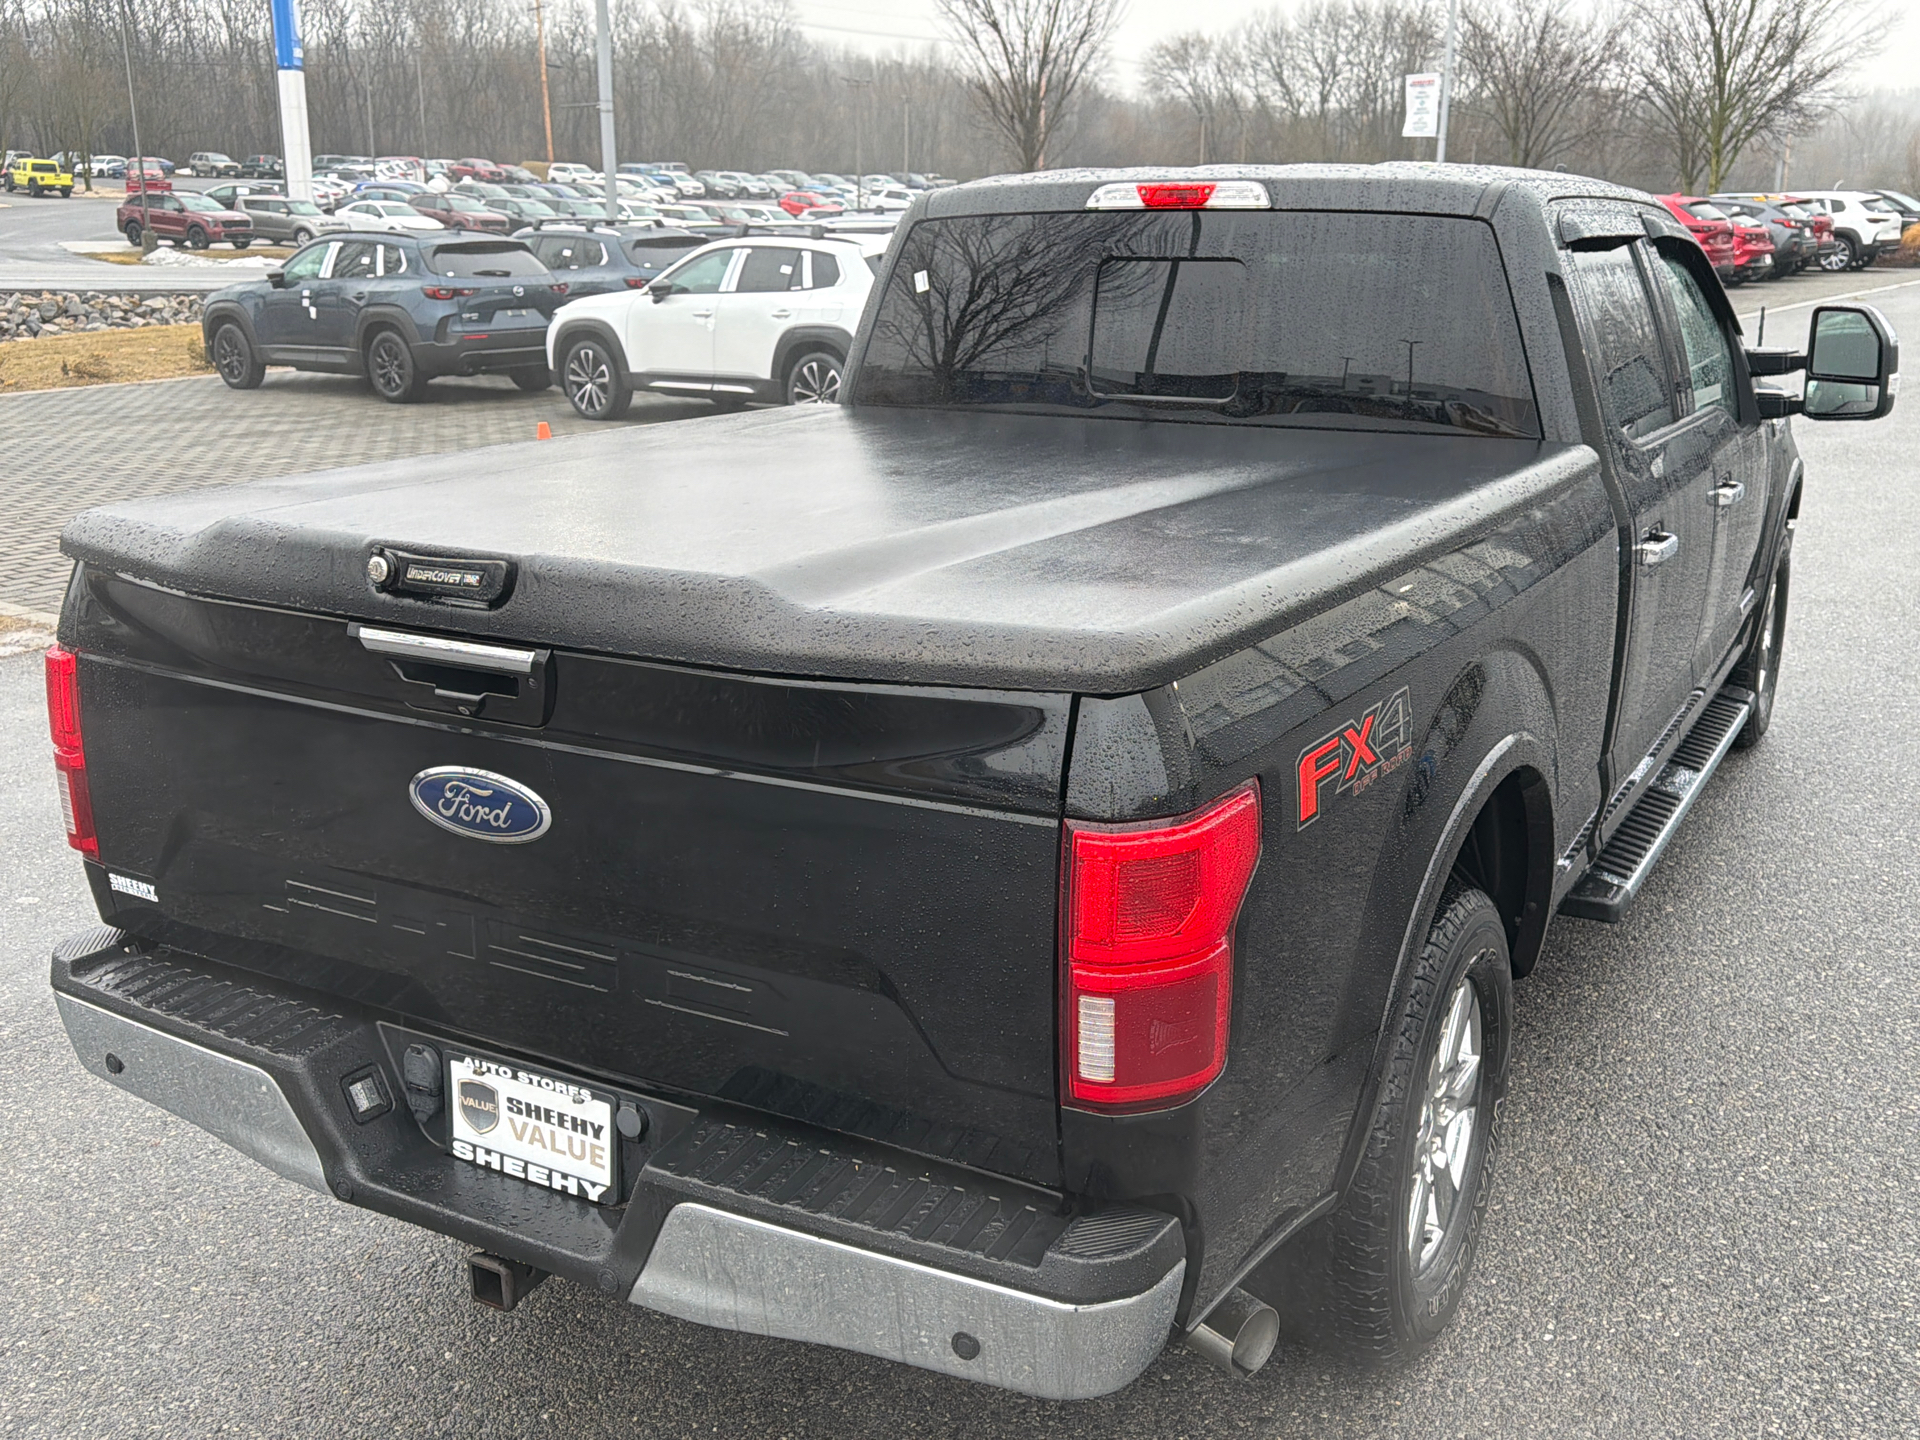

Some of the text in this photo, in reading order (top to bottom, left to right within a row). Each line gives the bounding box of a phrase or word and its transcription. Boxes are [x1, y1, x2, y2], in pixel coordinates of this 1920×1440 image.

[1295, 685, 1413, 832] FX4
[1353, 746, 1413, 796] OFF ROAD
[438, 781, 512, 828] Ford
[108, 873, 155, 895] SHEEHY
[463, 1056, 592, 1102] AUTO STORES
[461, 1095, 497, 1113] VALUE
[506, 1096, 604, 1141] SHEEHY
[507, 1116, 606, 1170] VALUE
[452, 1140, 607, 1202] SHEEHY
